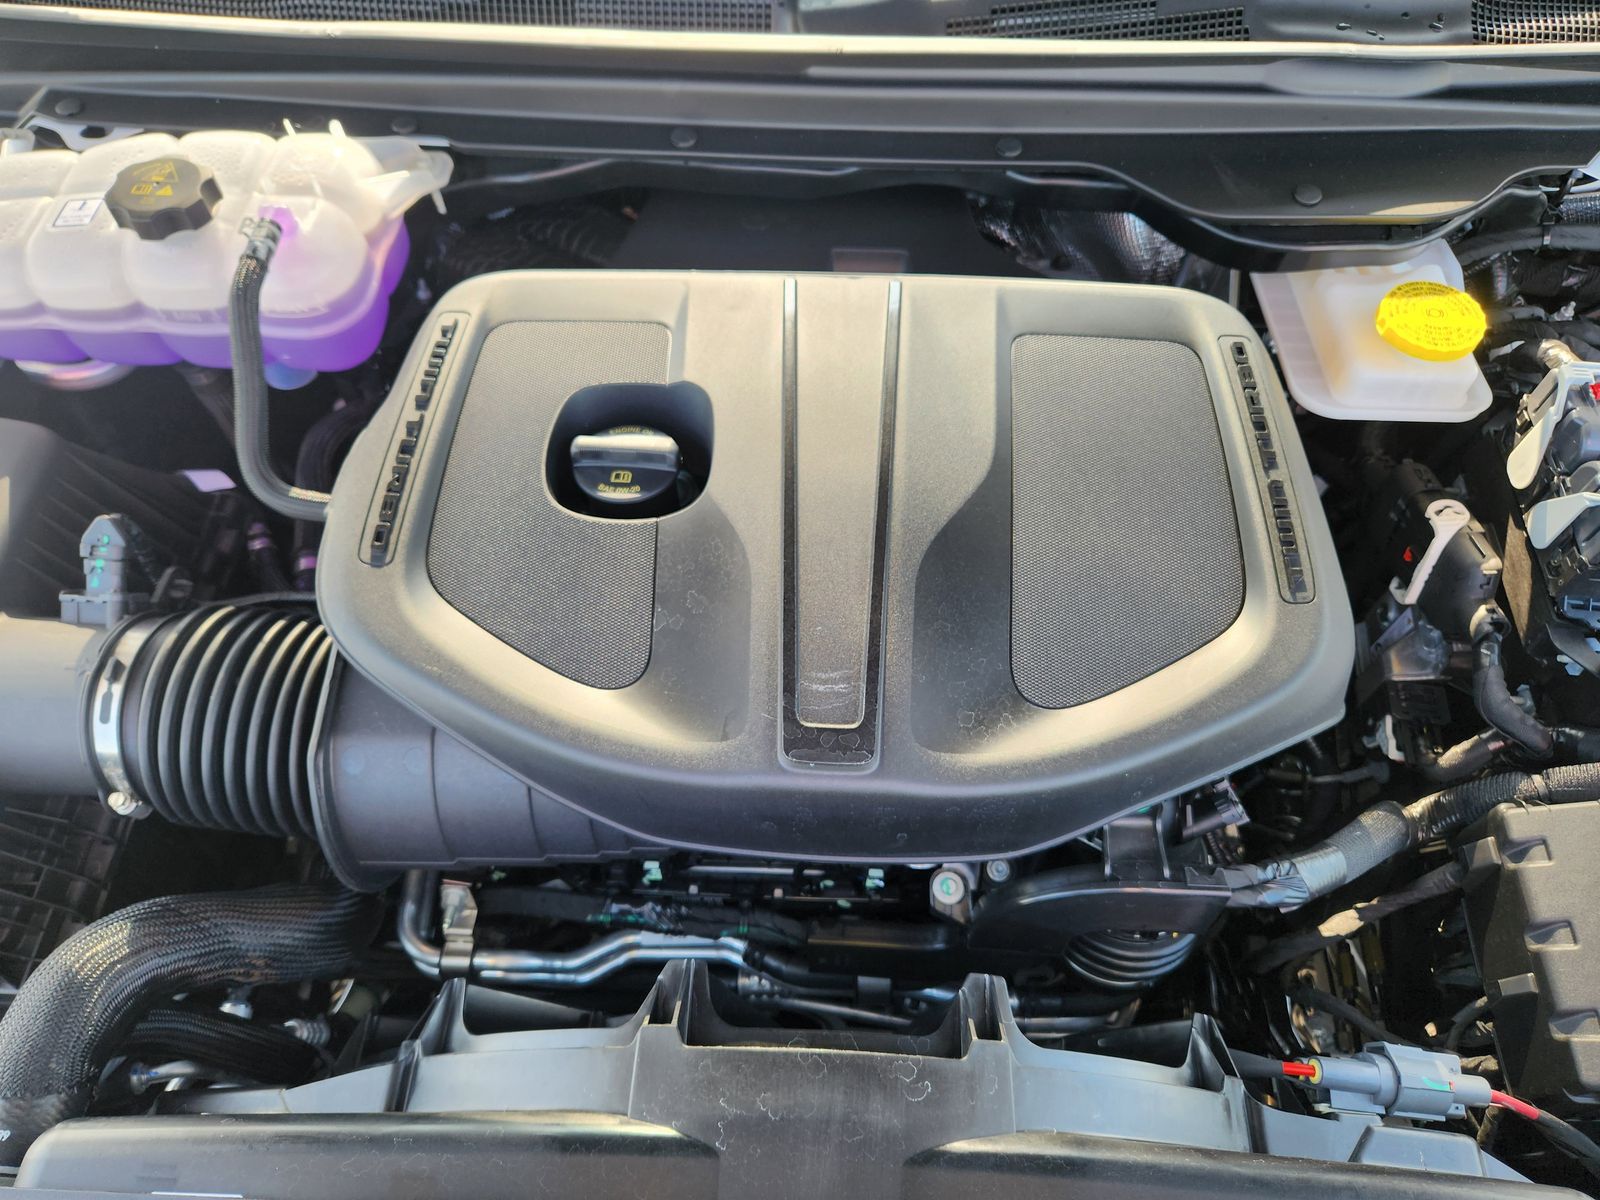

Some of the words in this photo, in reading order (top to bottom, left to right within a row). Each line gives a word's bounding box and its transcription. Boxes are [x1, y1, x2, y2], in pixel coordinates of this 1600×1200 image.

[415, 318, 458, 411] TWIN
[1230, 341, 1278, 479] TURBO
[371, 414, 424, 552] TURBO
[1268, 480, 1307, 599] TWIN
